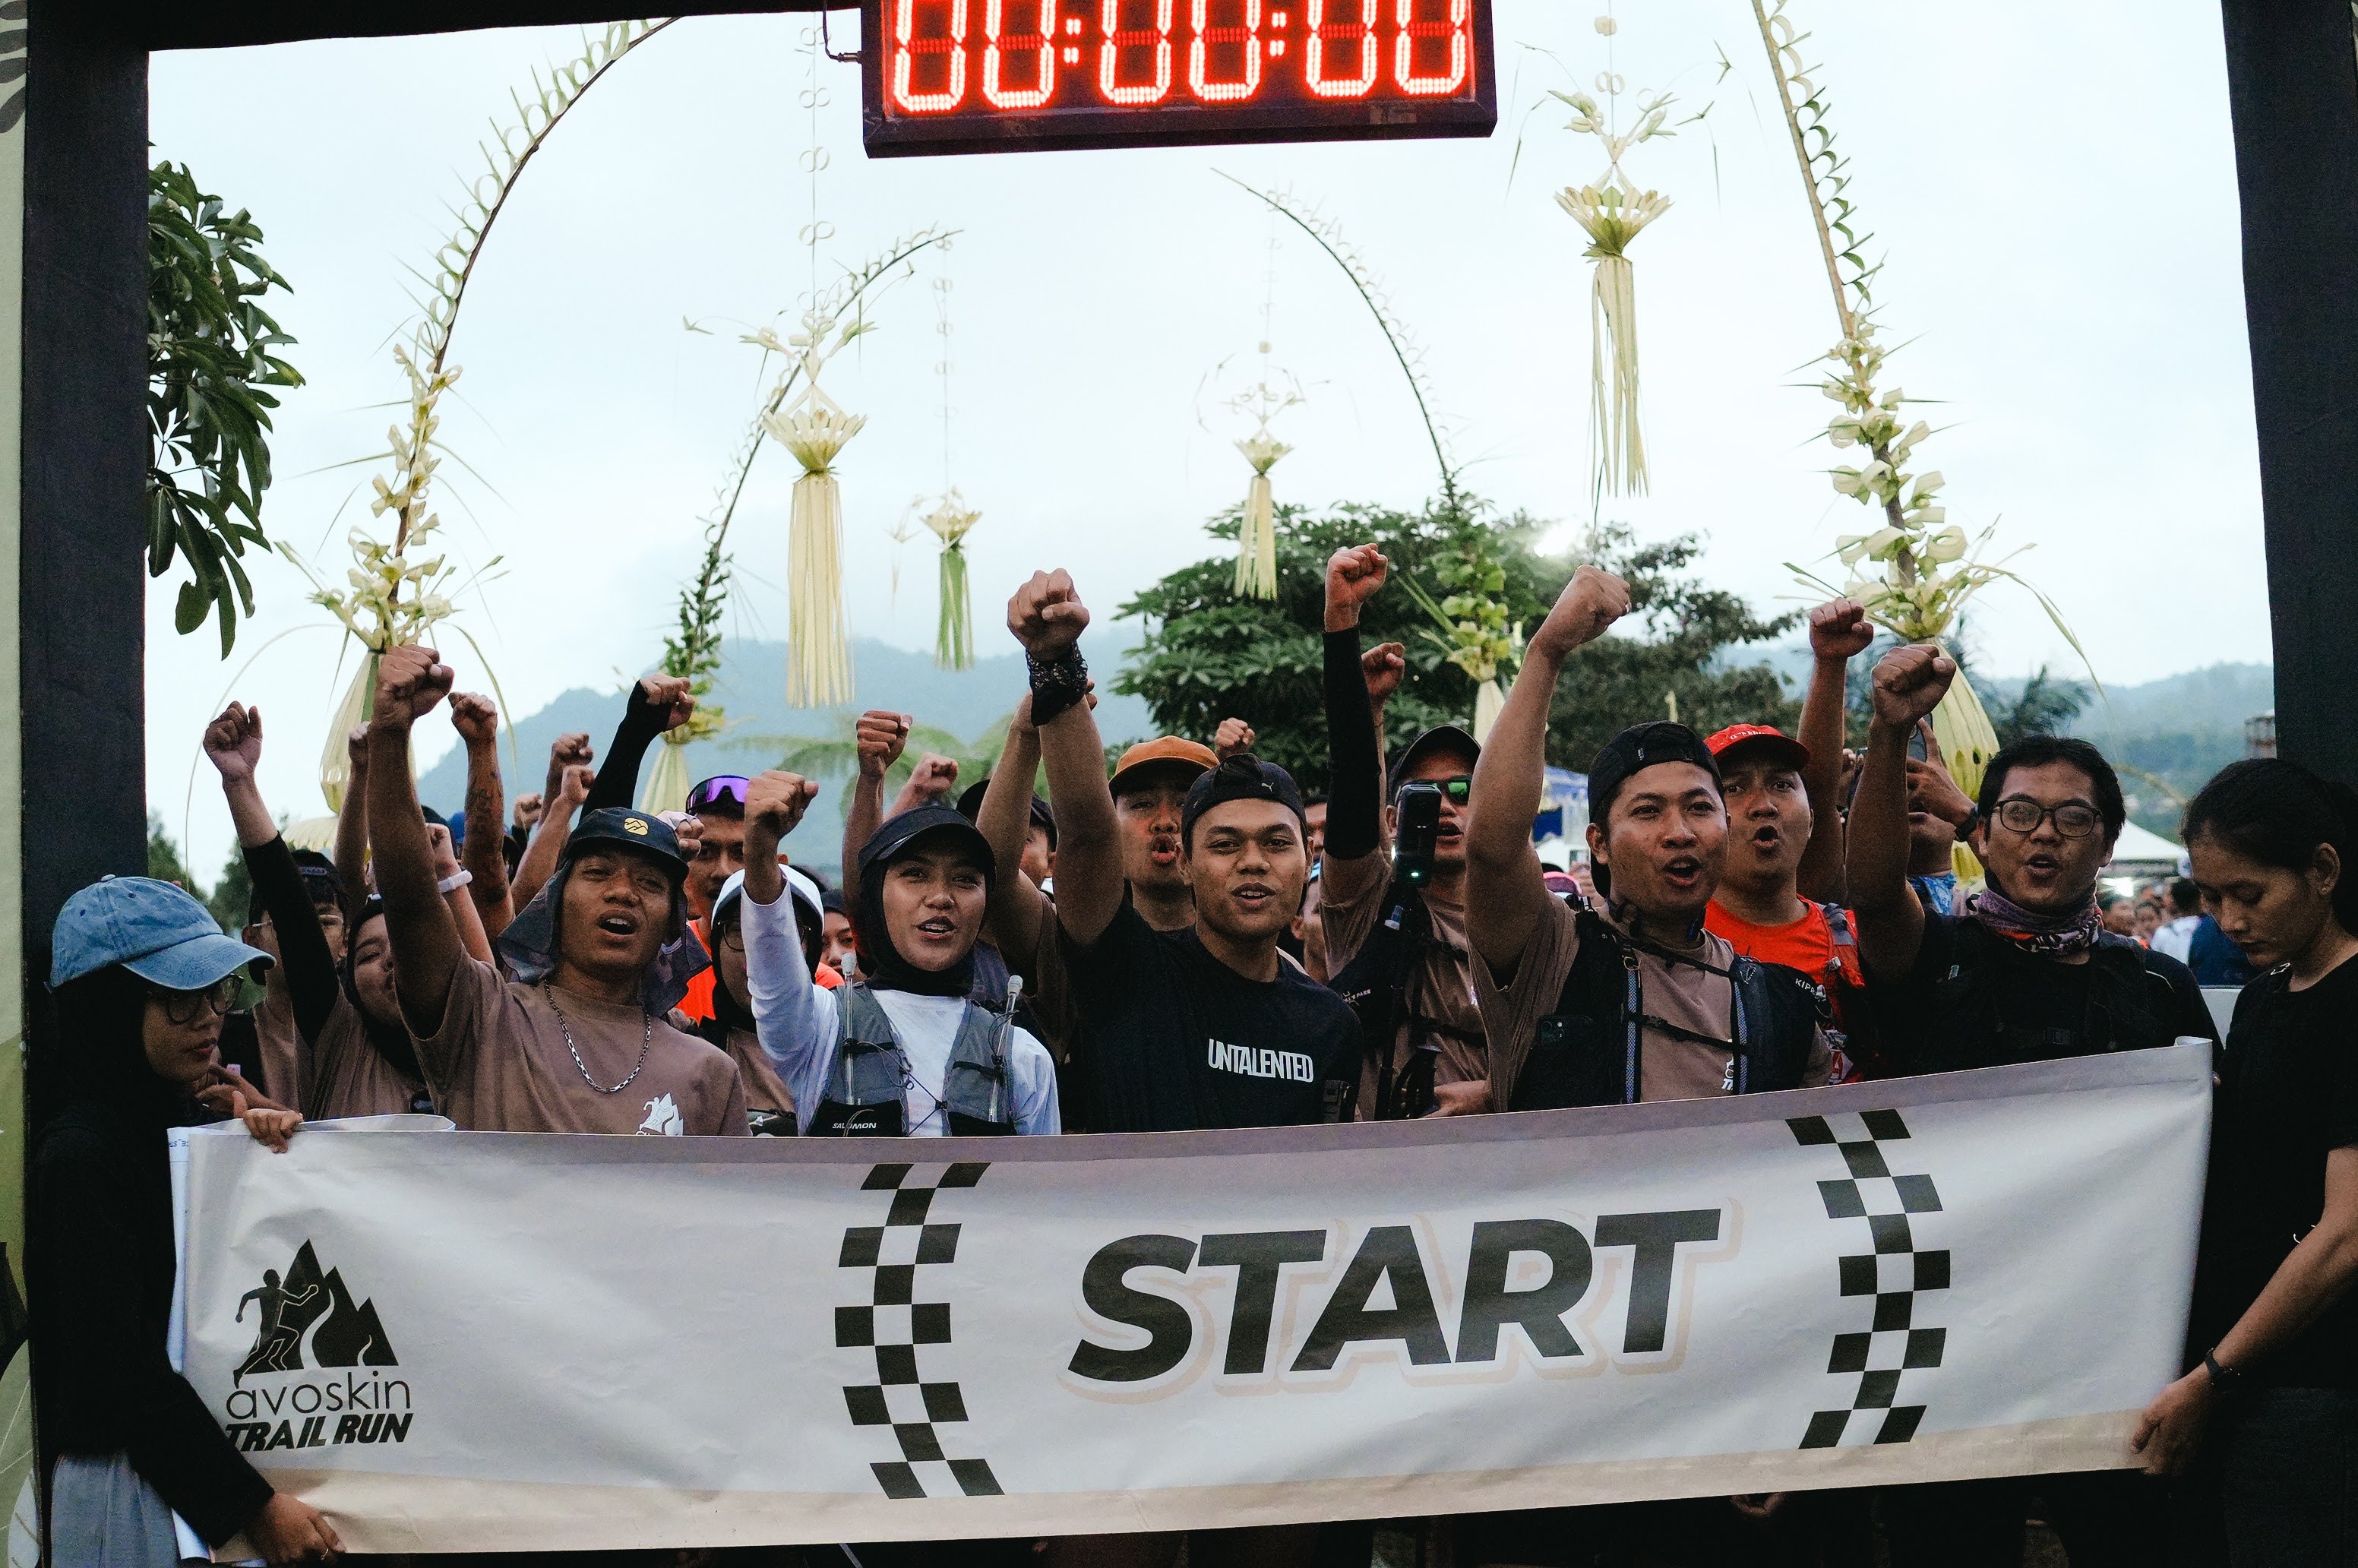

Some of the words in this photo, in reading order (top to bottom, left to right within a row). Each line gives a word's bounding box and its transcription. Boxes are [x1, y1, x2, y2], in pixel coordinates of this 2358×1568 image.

[1208, 1038, 1314, 1083] UNTALENTED
[1067, 1208, 1721, 1383] START
[226, 1370, 411, 1420] avoskin
[225, 1415, 328, 1453] TRAIL
[331, 1412, 414, 1445] RUN
